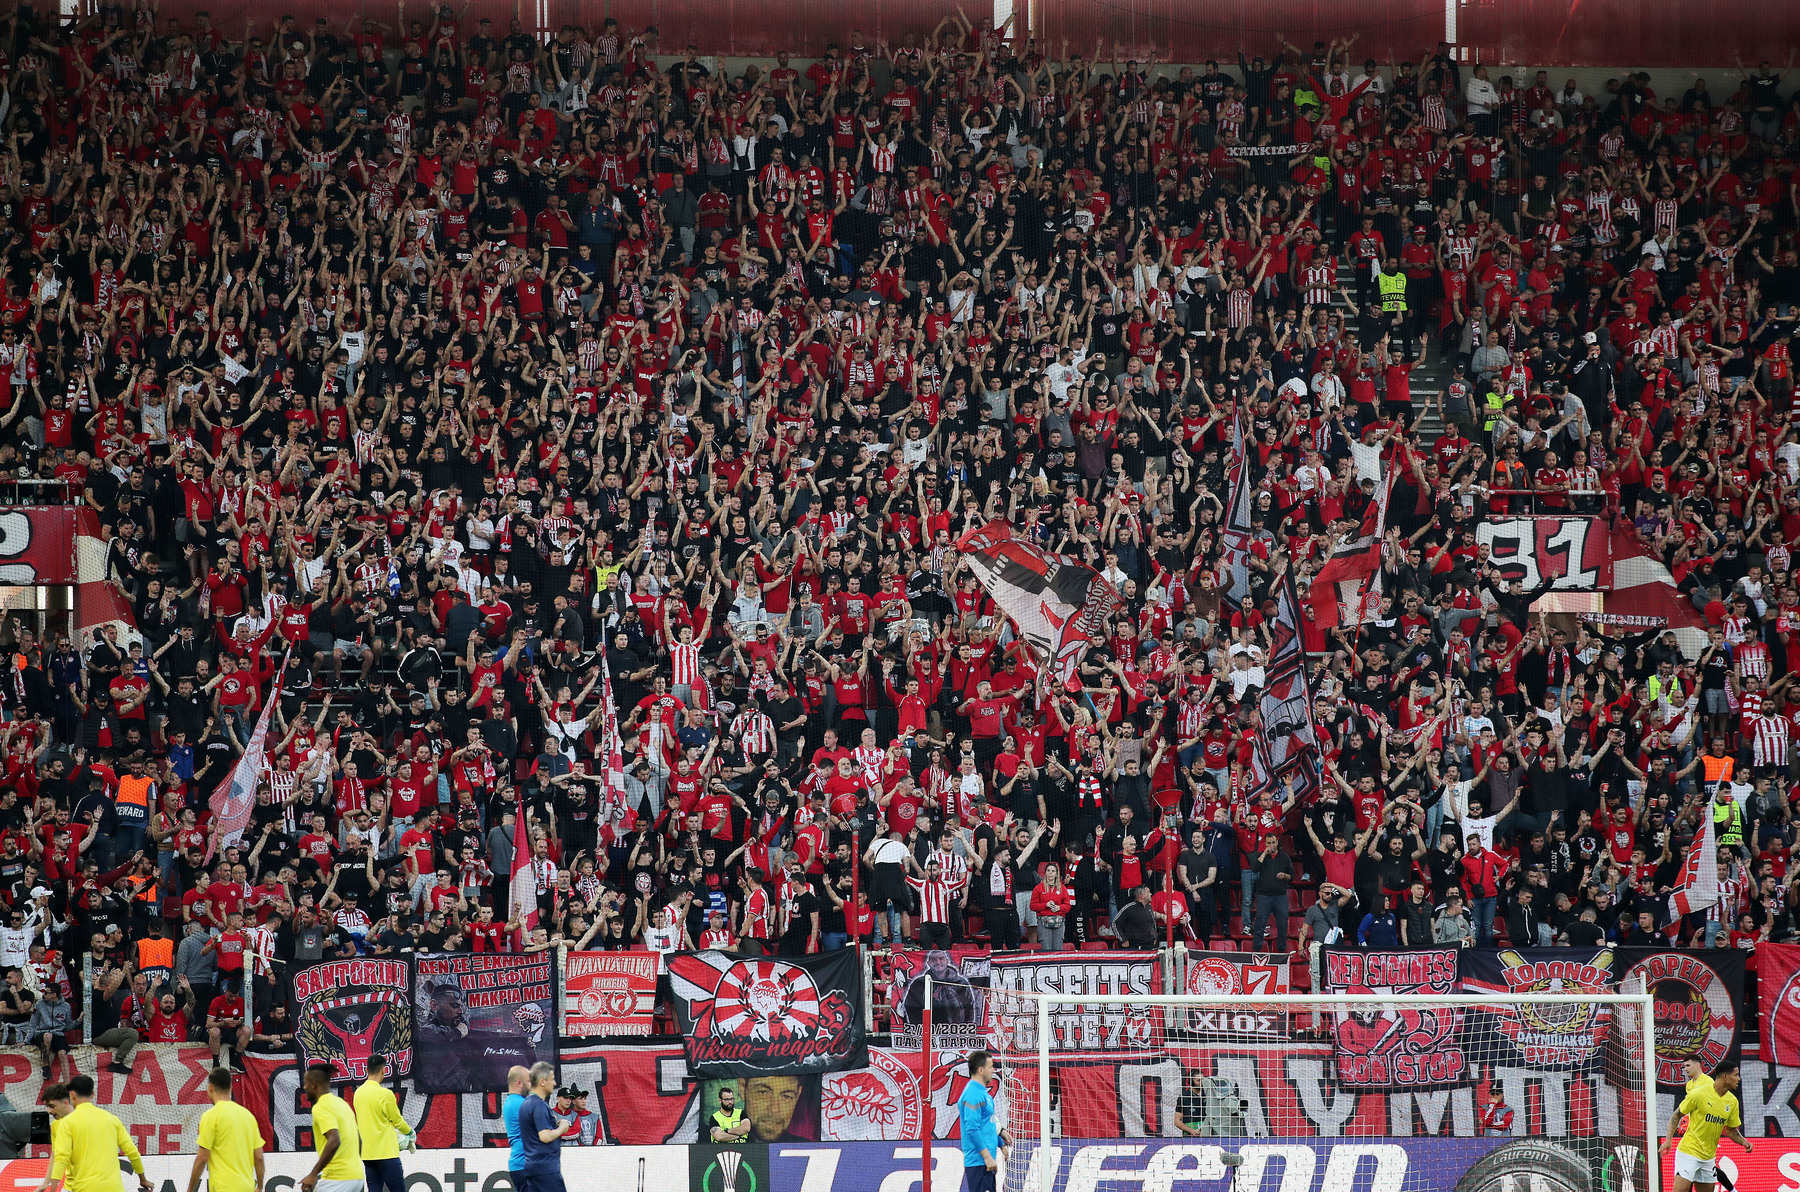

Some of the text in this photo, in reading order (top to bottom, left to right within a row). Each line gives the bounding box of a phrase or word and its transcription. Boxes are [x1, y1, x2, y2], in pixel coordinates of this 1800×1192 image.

[1228, 144, 1297, 157] ΧΑΛΚΙΔΑ
[419, 959, 450, 975] ΔΕΝ
[451, 957, 470, 973] ΣΕ
[460, 965, 550, 990] ΚΙ ΑΣ ΕΦΥΓΕΣ
[567, 956, 656, 983] MANIATIKA
[1329, 949, 1459, 986] RED SICKNESS
[1501, 961, 1613, 988] ΚΟΛΩΝΟΣ
[1633, 956, 1714, 993] ΒΟΡΕΙΑ
[294, 958, 409, 1002] SANTORINI
[592, 977, 630, 989] PIRAEUS
[989, 964, 1154, 1014] MISFITS
[468, 983, 552, 1008] ΜΑΚΡΙΑ ΜΑΣ
[1195, 1011, 1279, 1033] ΧΙΟΣ
[1653, 1001, 1704, 1024] 990
[940, 1036, 986, 1048] ΠΑΡΩΝ
[1516, 1031, 1595, 1046] ΟΛΥΜΠΙΑΚΟΣ
[1654, 1025, 1675, 1036] and
[1337, 1049, 1467, 1086] NON STOP
[1493, 1150, 1550, 1165] Laufenn
